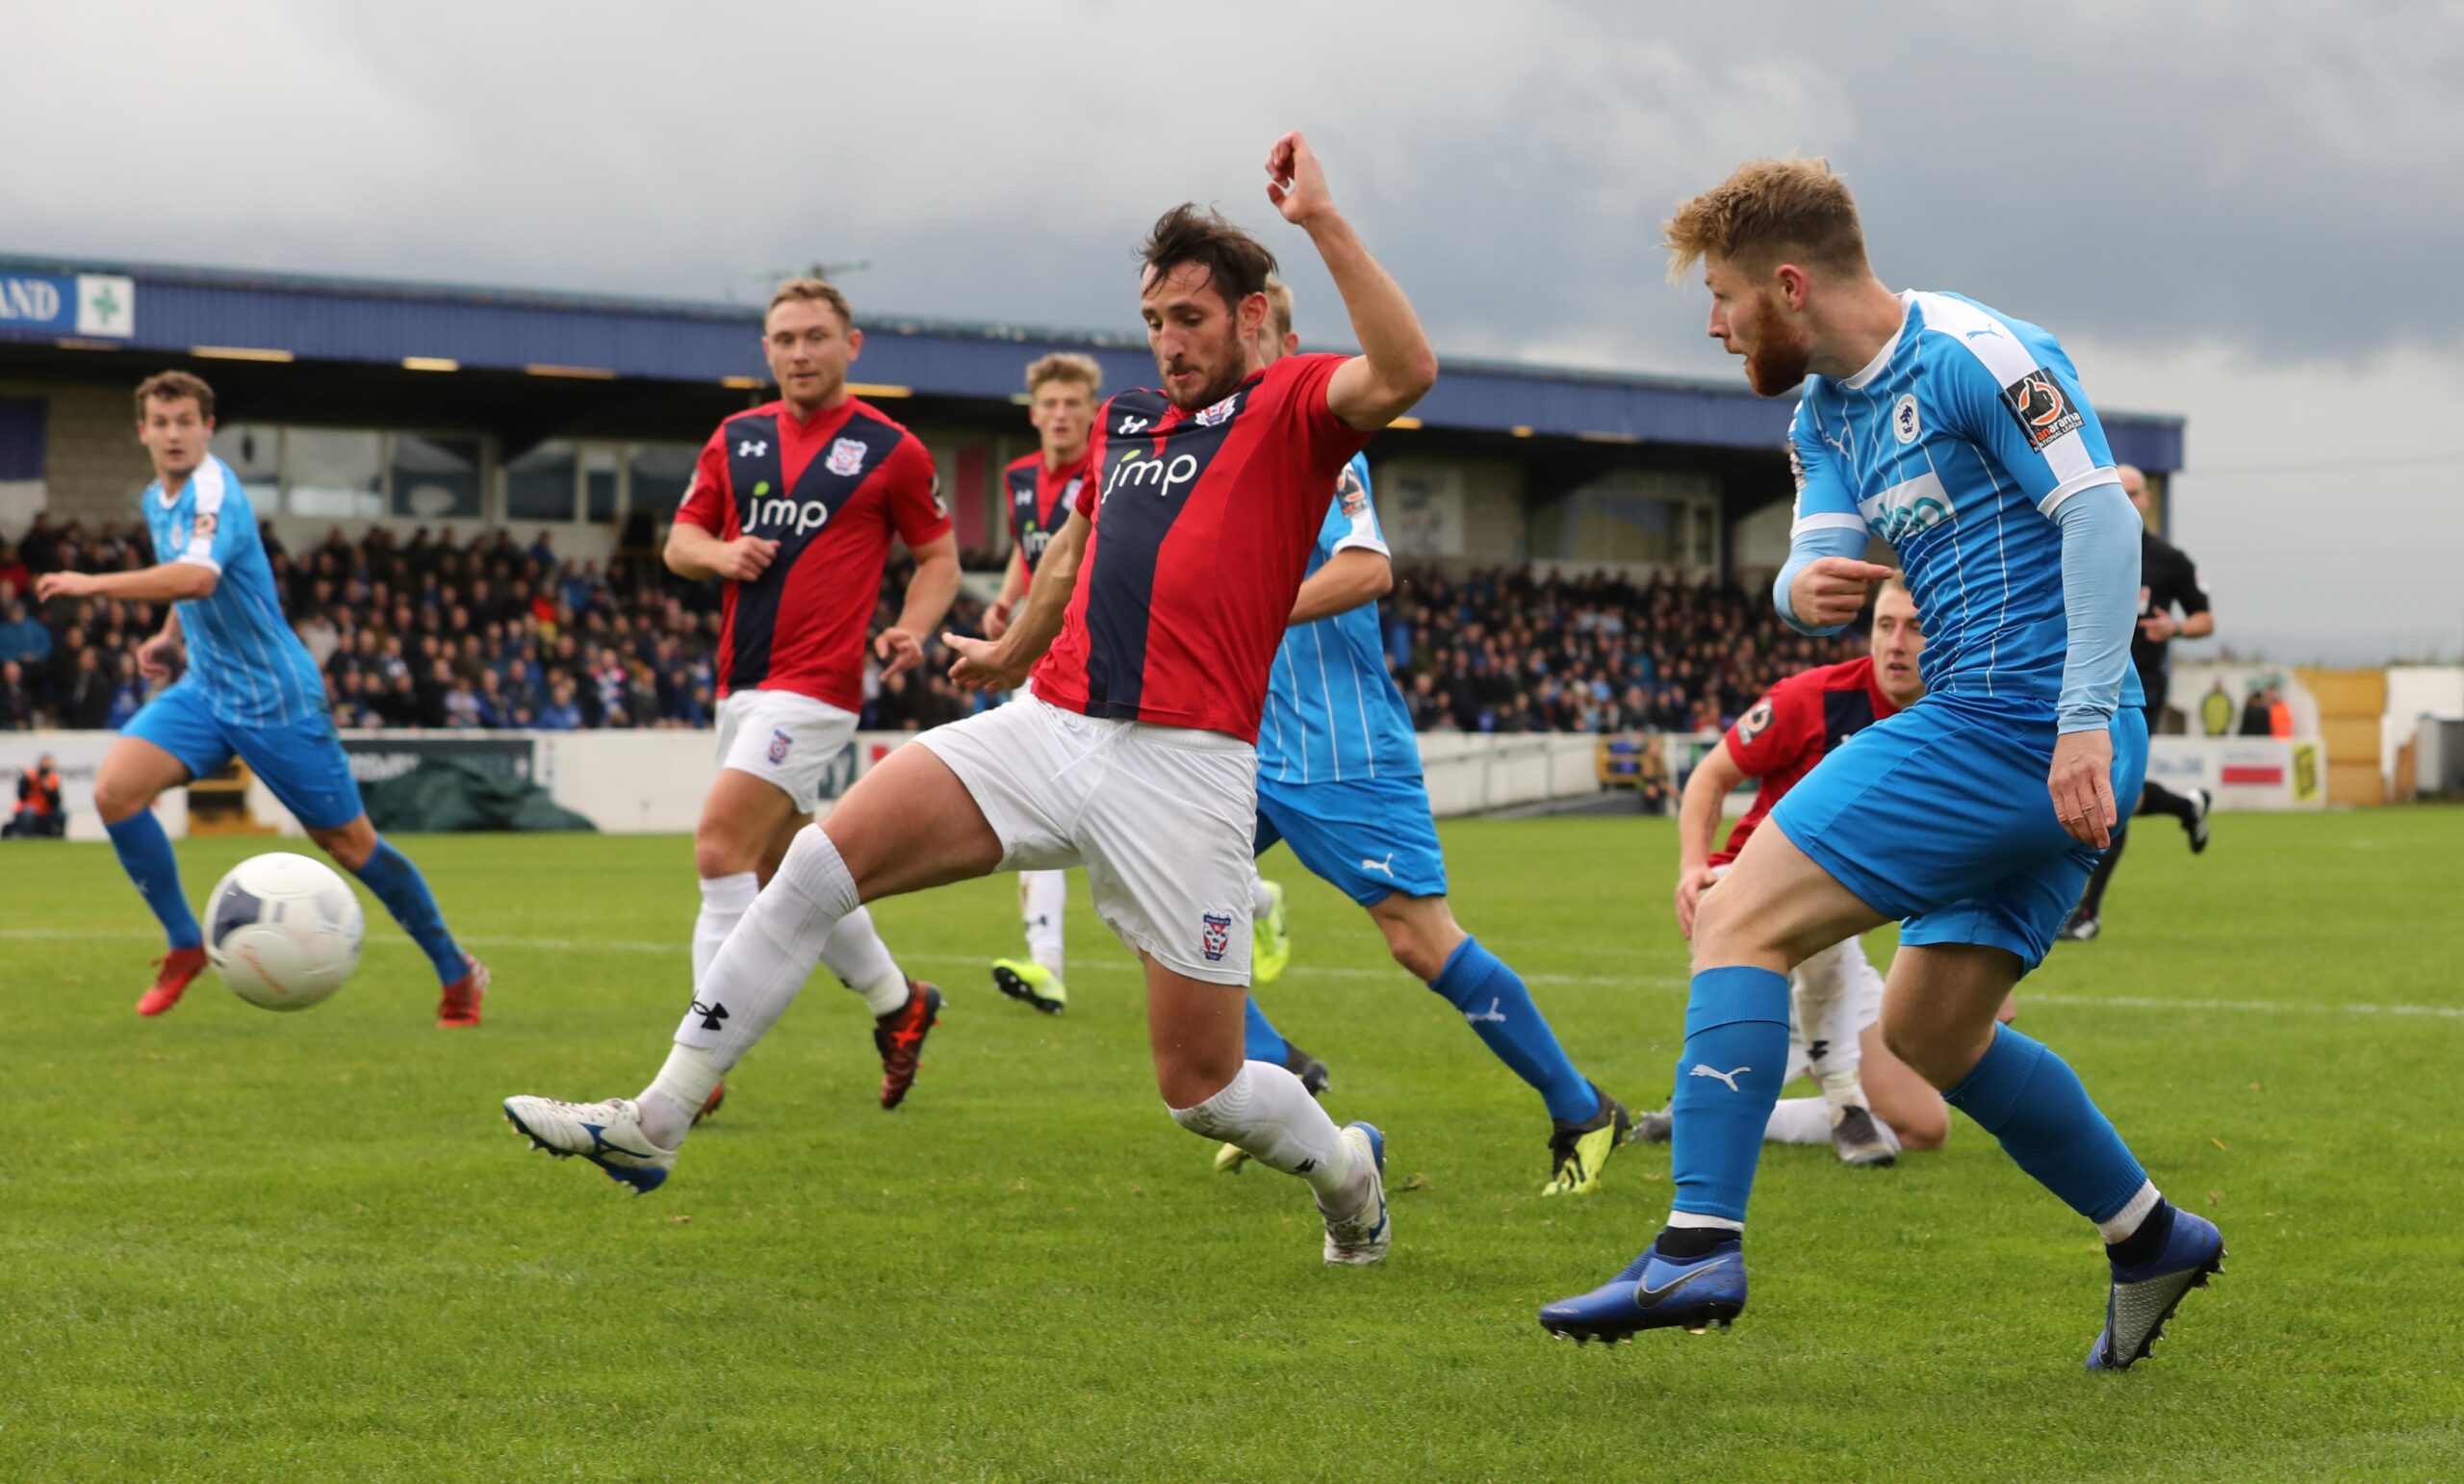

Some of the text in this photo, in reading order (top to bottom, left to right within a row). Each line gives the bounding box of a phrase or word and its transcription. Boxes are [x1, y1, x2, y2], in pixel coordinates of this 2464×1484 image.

[1100, 448, 1197, 504] jmp
[741, 481, 828, 536] jmp
[1022, 520, 1051, 561] jm
